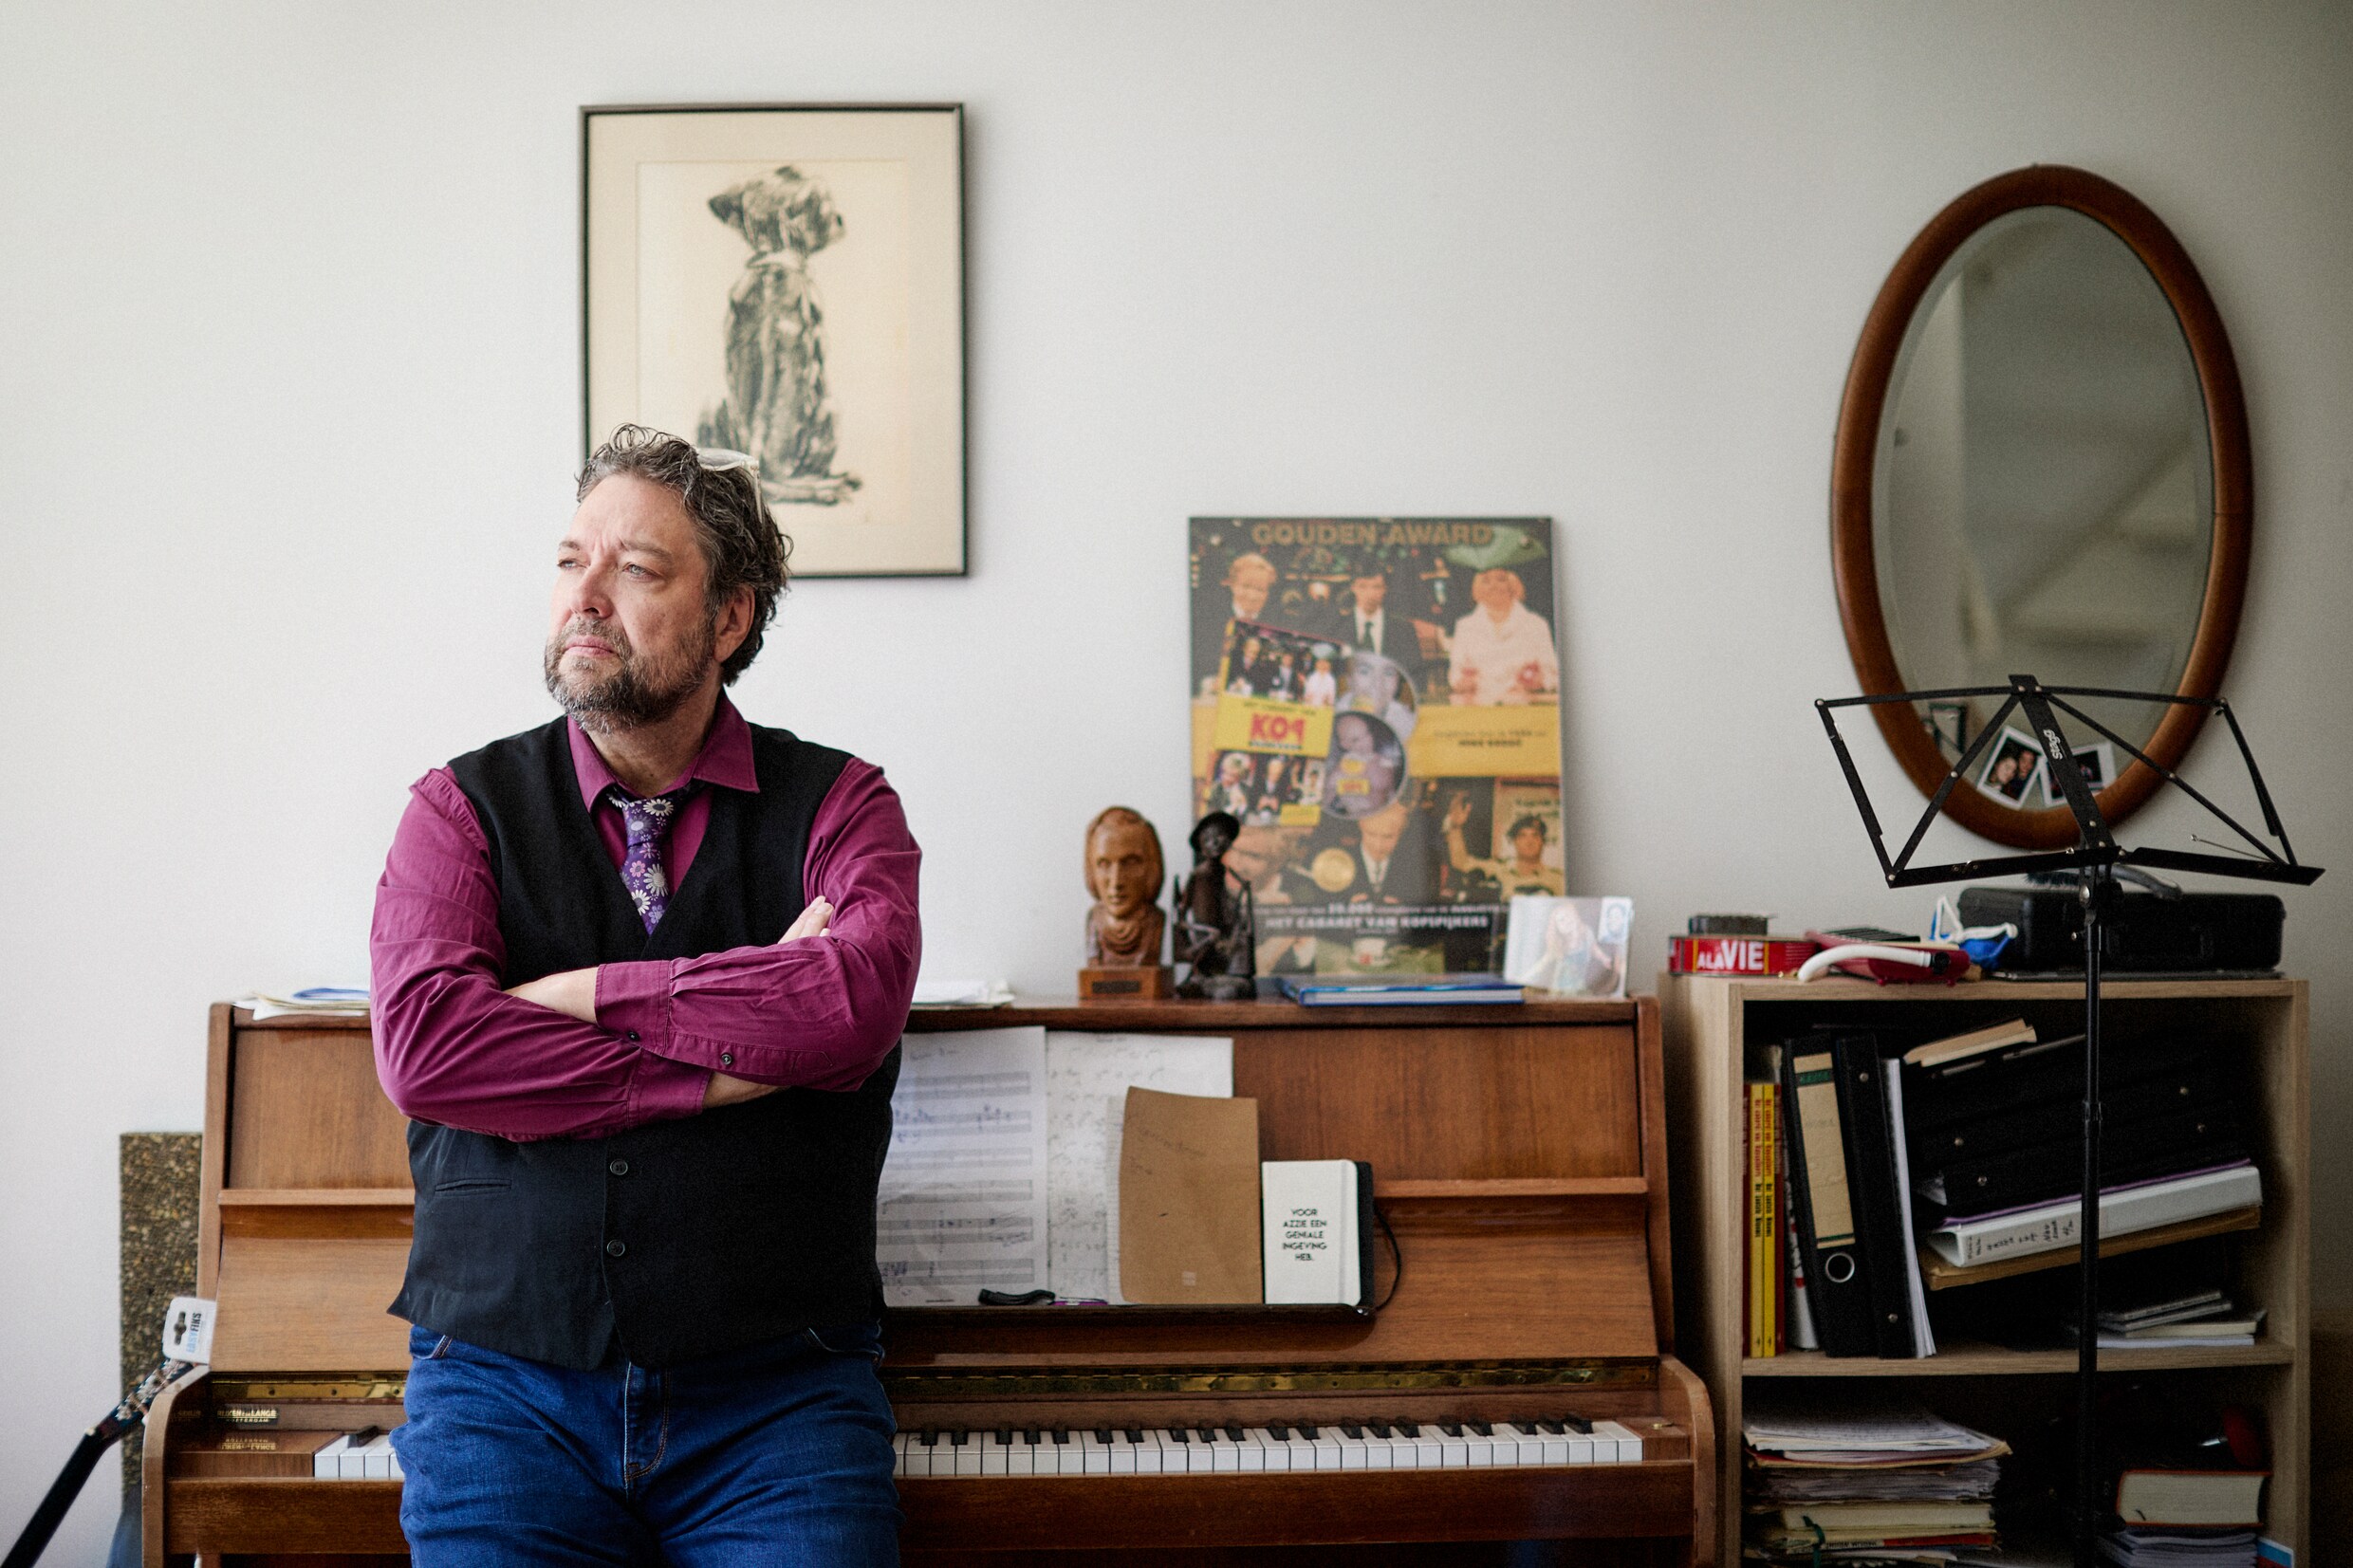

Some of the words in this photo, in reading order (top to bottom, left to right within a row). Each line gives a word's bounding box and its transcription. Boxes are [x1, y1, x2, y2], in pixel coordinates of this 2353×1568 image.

[1251, 523, 1376, 545] GOUDEN
[1386, 523, 1495, 545] AWARD
[2043, 729, 2064, 760] Stagg
[1720, 939, 1765, 970] VIE
[1290, 1208, 1318, 1216] VOOR
[1310, 1219, 1327, 1227] EEN
[1285, 1230, 1324, 1239] GENIALE
[1283, 1242, 1327, 1250] INGEVING
